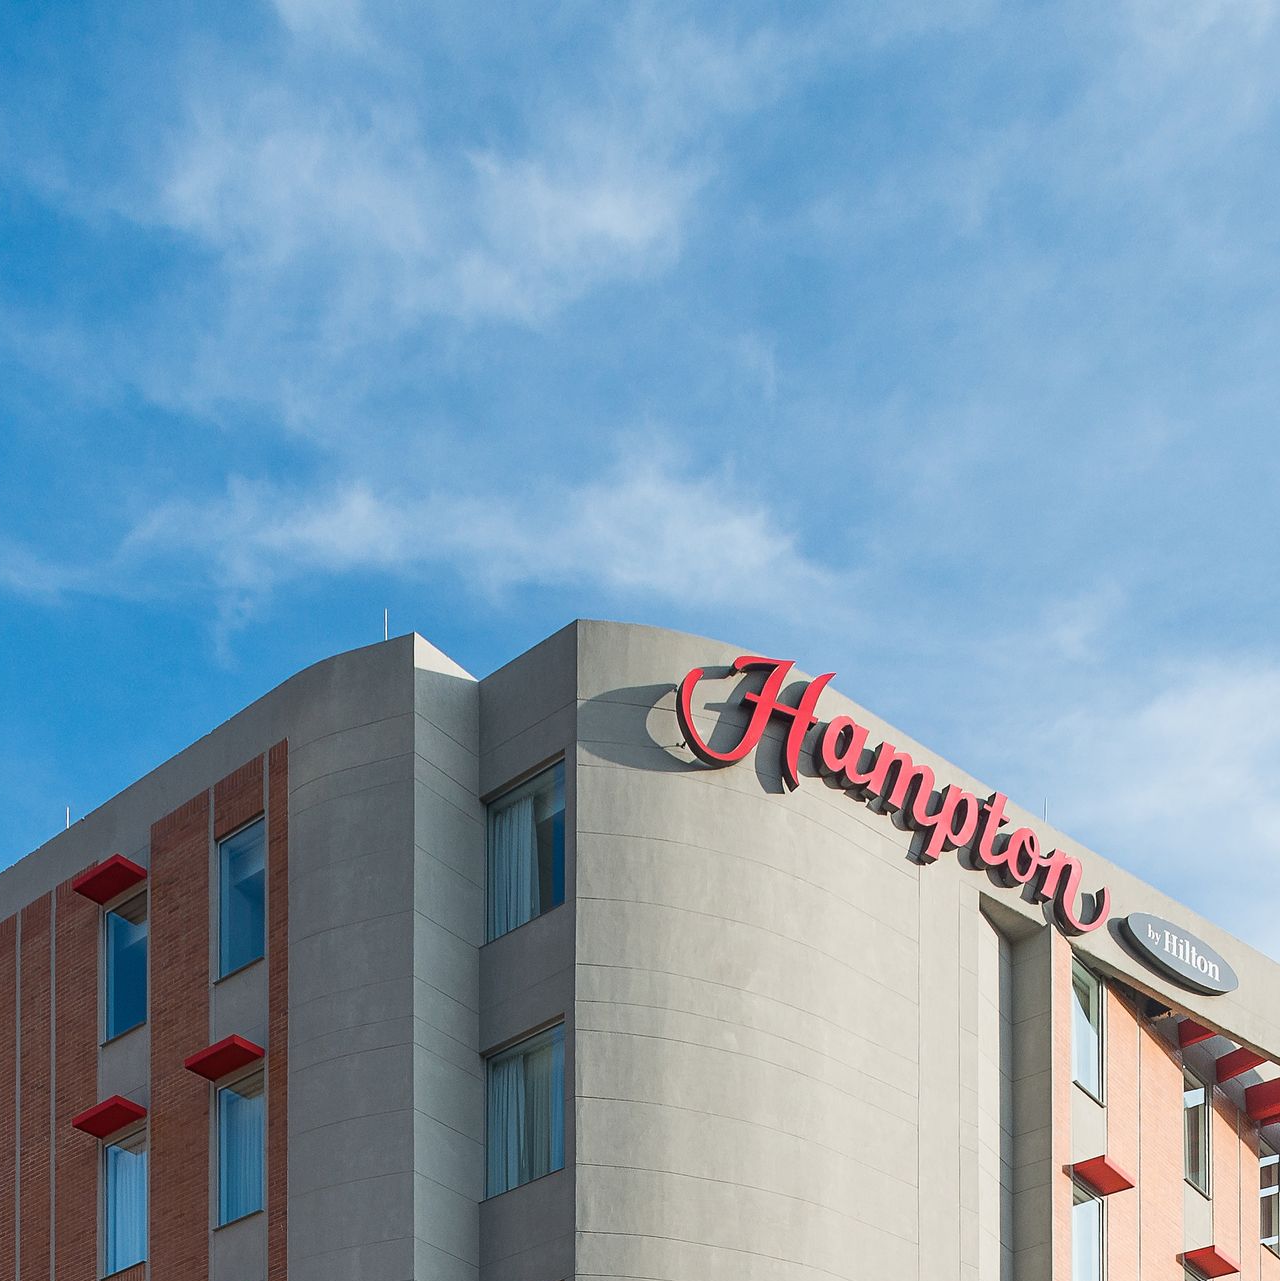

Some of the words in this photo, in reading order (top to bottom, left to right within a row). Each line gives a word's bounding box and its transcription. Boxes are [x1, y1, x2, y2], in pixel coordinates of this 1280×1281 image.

[675, 656, 1111, 937] Hampton
[1147, 923, 1161, 945] by
[1163, 929, 1221, 983] Hilton
